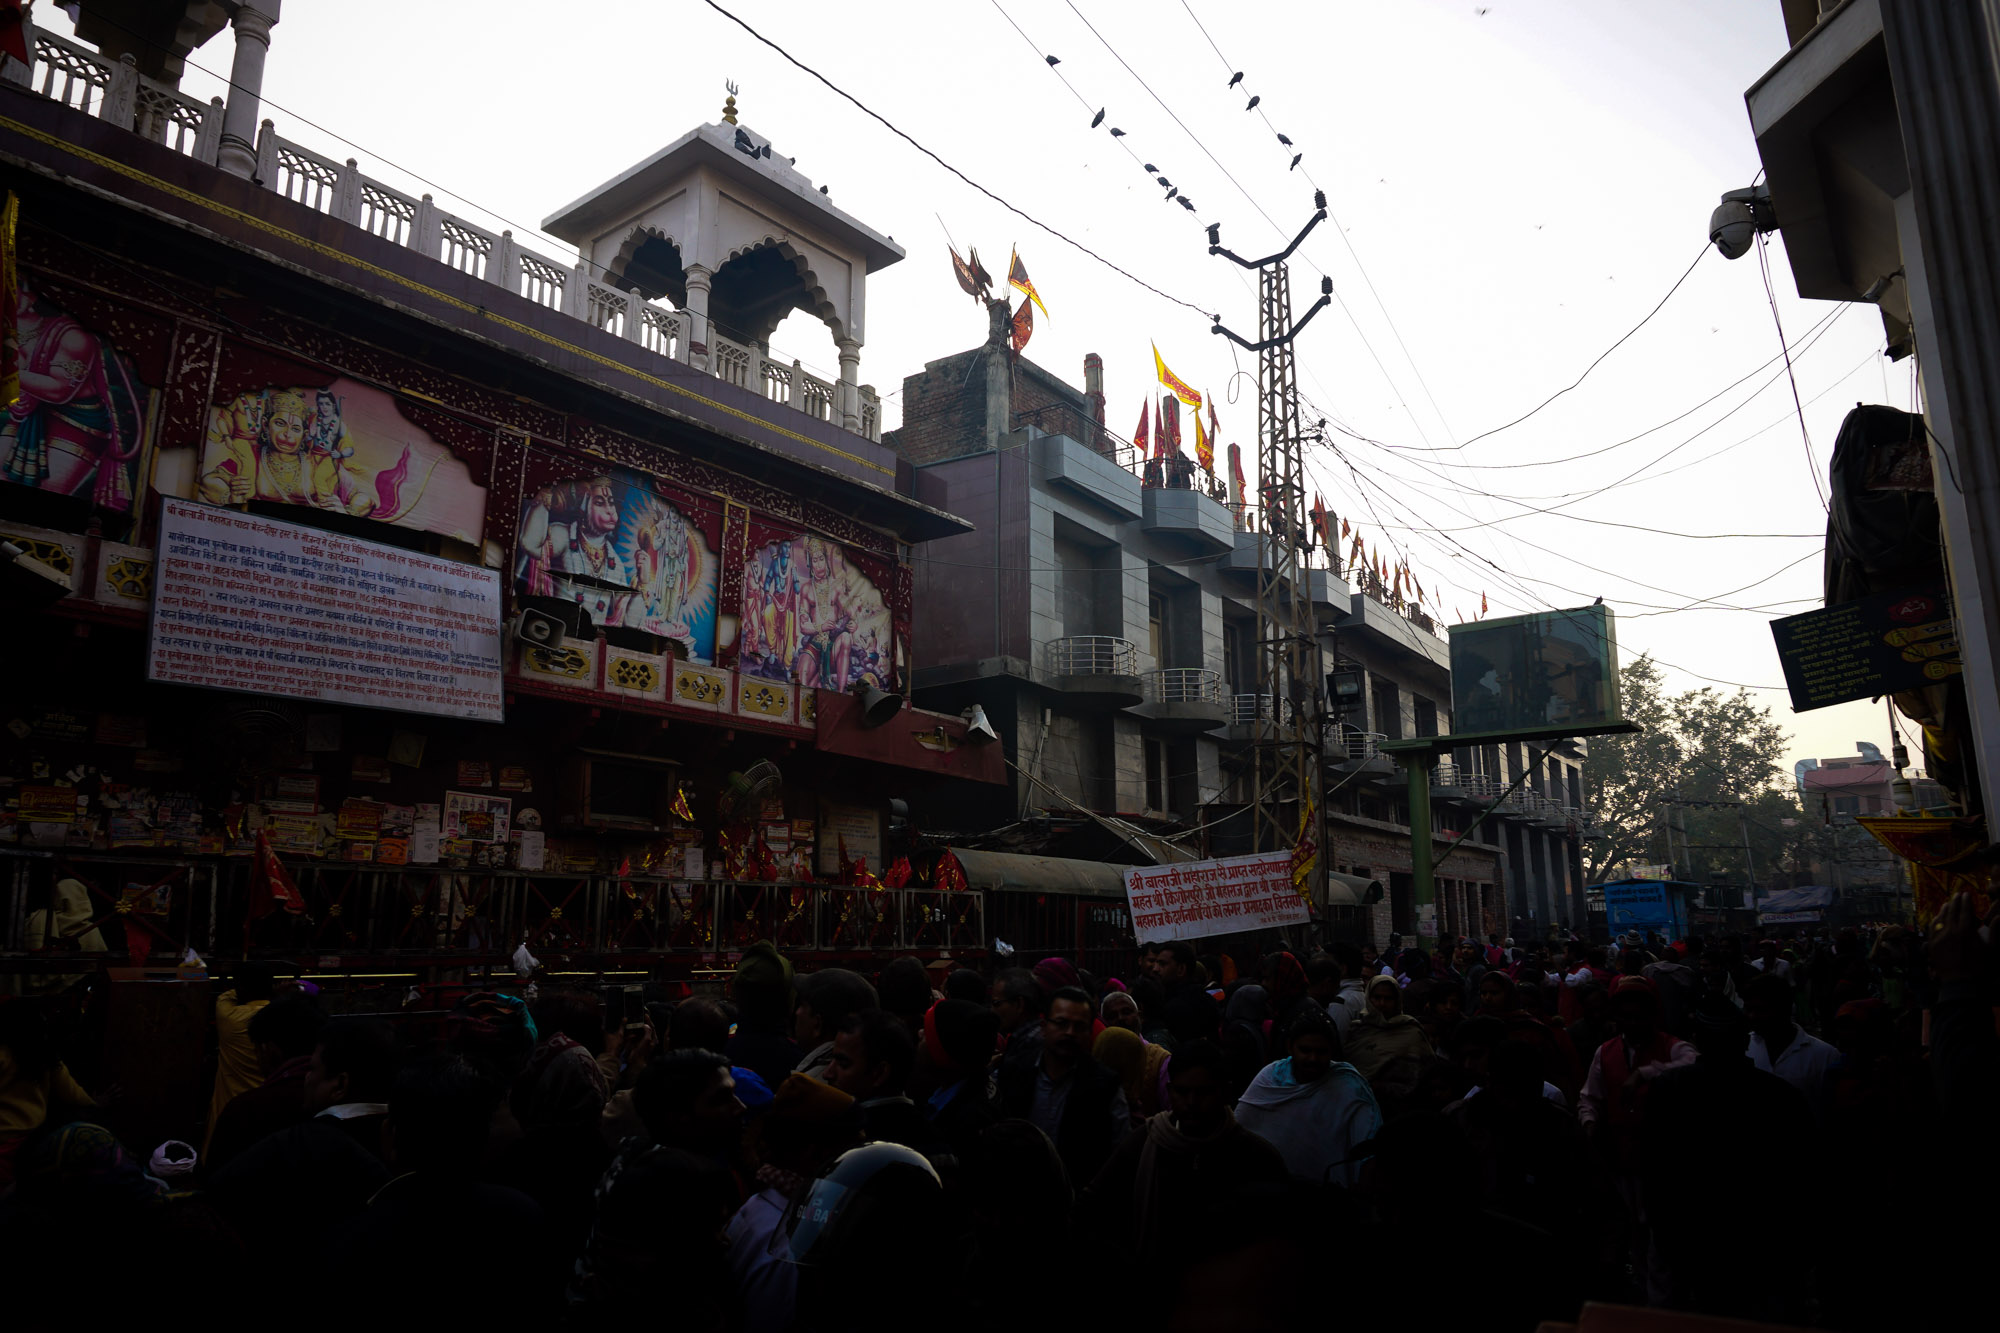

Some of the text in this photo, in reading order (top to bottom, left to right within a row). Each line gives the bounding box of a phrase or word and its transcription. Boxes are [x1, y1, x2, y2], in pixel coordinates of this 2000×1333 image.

[1129, 873, 1143, 890] श्री
[1145, 868, 1181, 889] बालाजी
[1183, 868, 1216, 884] महाराज
[1226, 865, 1247, 880] प्राप्त
[1153, 892, 1163, 907] श्री
[1165, 886, 1203, 907] किशोरपुरी
[1205, 885, 1215, 899] जी
[1216, 884, 1242, 899] महाराज
[1243, 881, 1258, 898] द्वारा
[1259, 878, 1269, 893] श्री
[1270, 877, 1294, 892] बालाज
[1135, 914, 1164, 929] महाराज
[1274, 894, 1301, 912] वितरण
